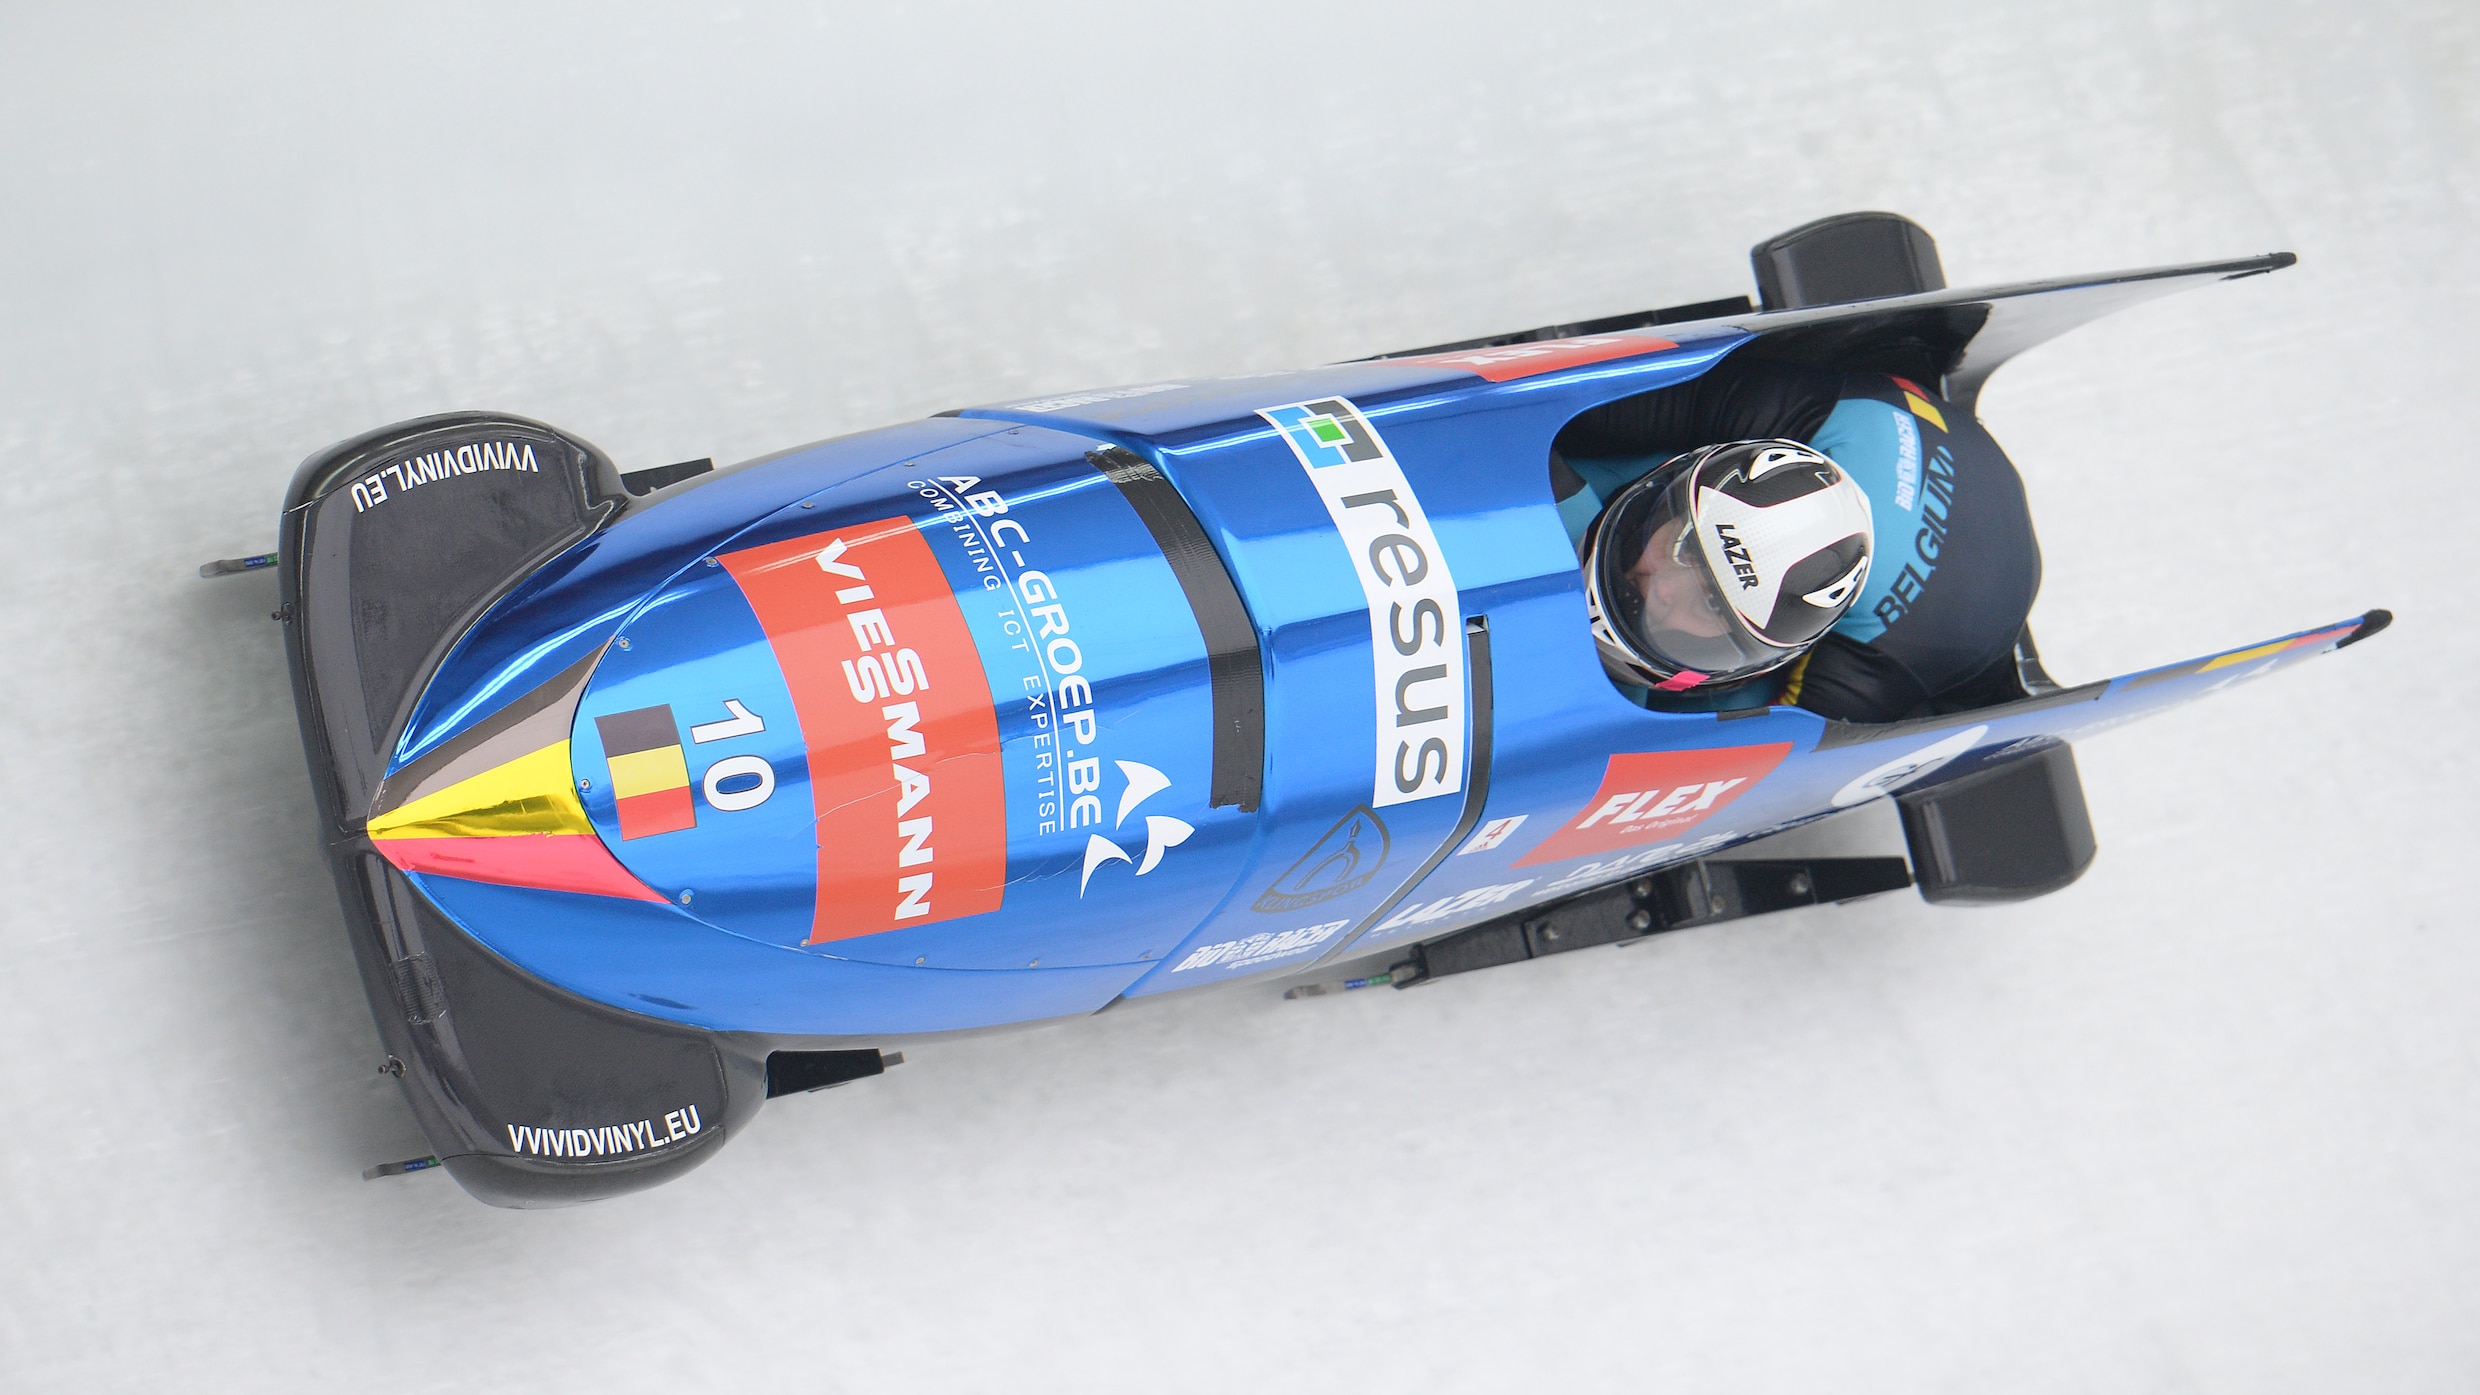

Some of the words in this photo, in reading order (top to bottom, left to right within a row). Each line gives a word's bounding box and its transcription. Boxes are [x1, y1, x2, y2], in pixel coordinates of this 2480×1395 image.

[350, 443, 540, 514] VVIVIDVINYL.EU
[1715, 523, 1760, 591] LAZER
[1874, 444, 1957, 632] BELGIUM
[907, 479, 999, 593] COMBINING
[997, 610, 1030, 653] ICT
[1022, 676, 1057, 837] EXPERTISE
[938, 474, 1102, 830] ABC-GROEP.BE
[1340, 488, 1449, 795] resus
[689, 698, 777, 813] 10
[818, 538, 934, 922] VIESSMANN
[1576, 776, 1749, 830] FLEX
[1253, 919, 1350, 957] RACER
[1372, 879, 1535, 932] LAZER
[507, 1104, 703, 1158] VVIVIDVINYL.EU
